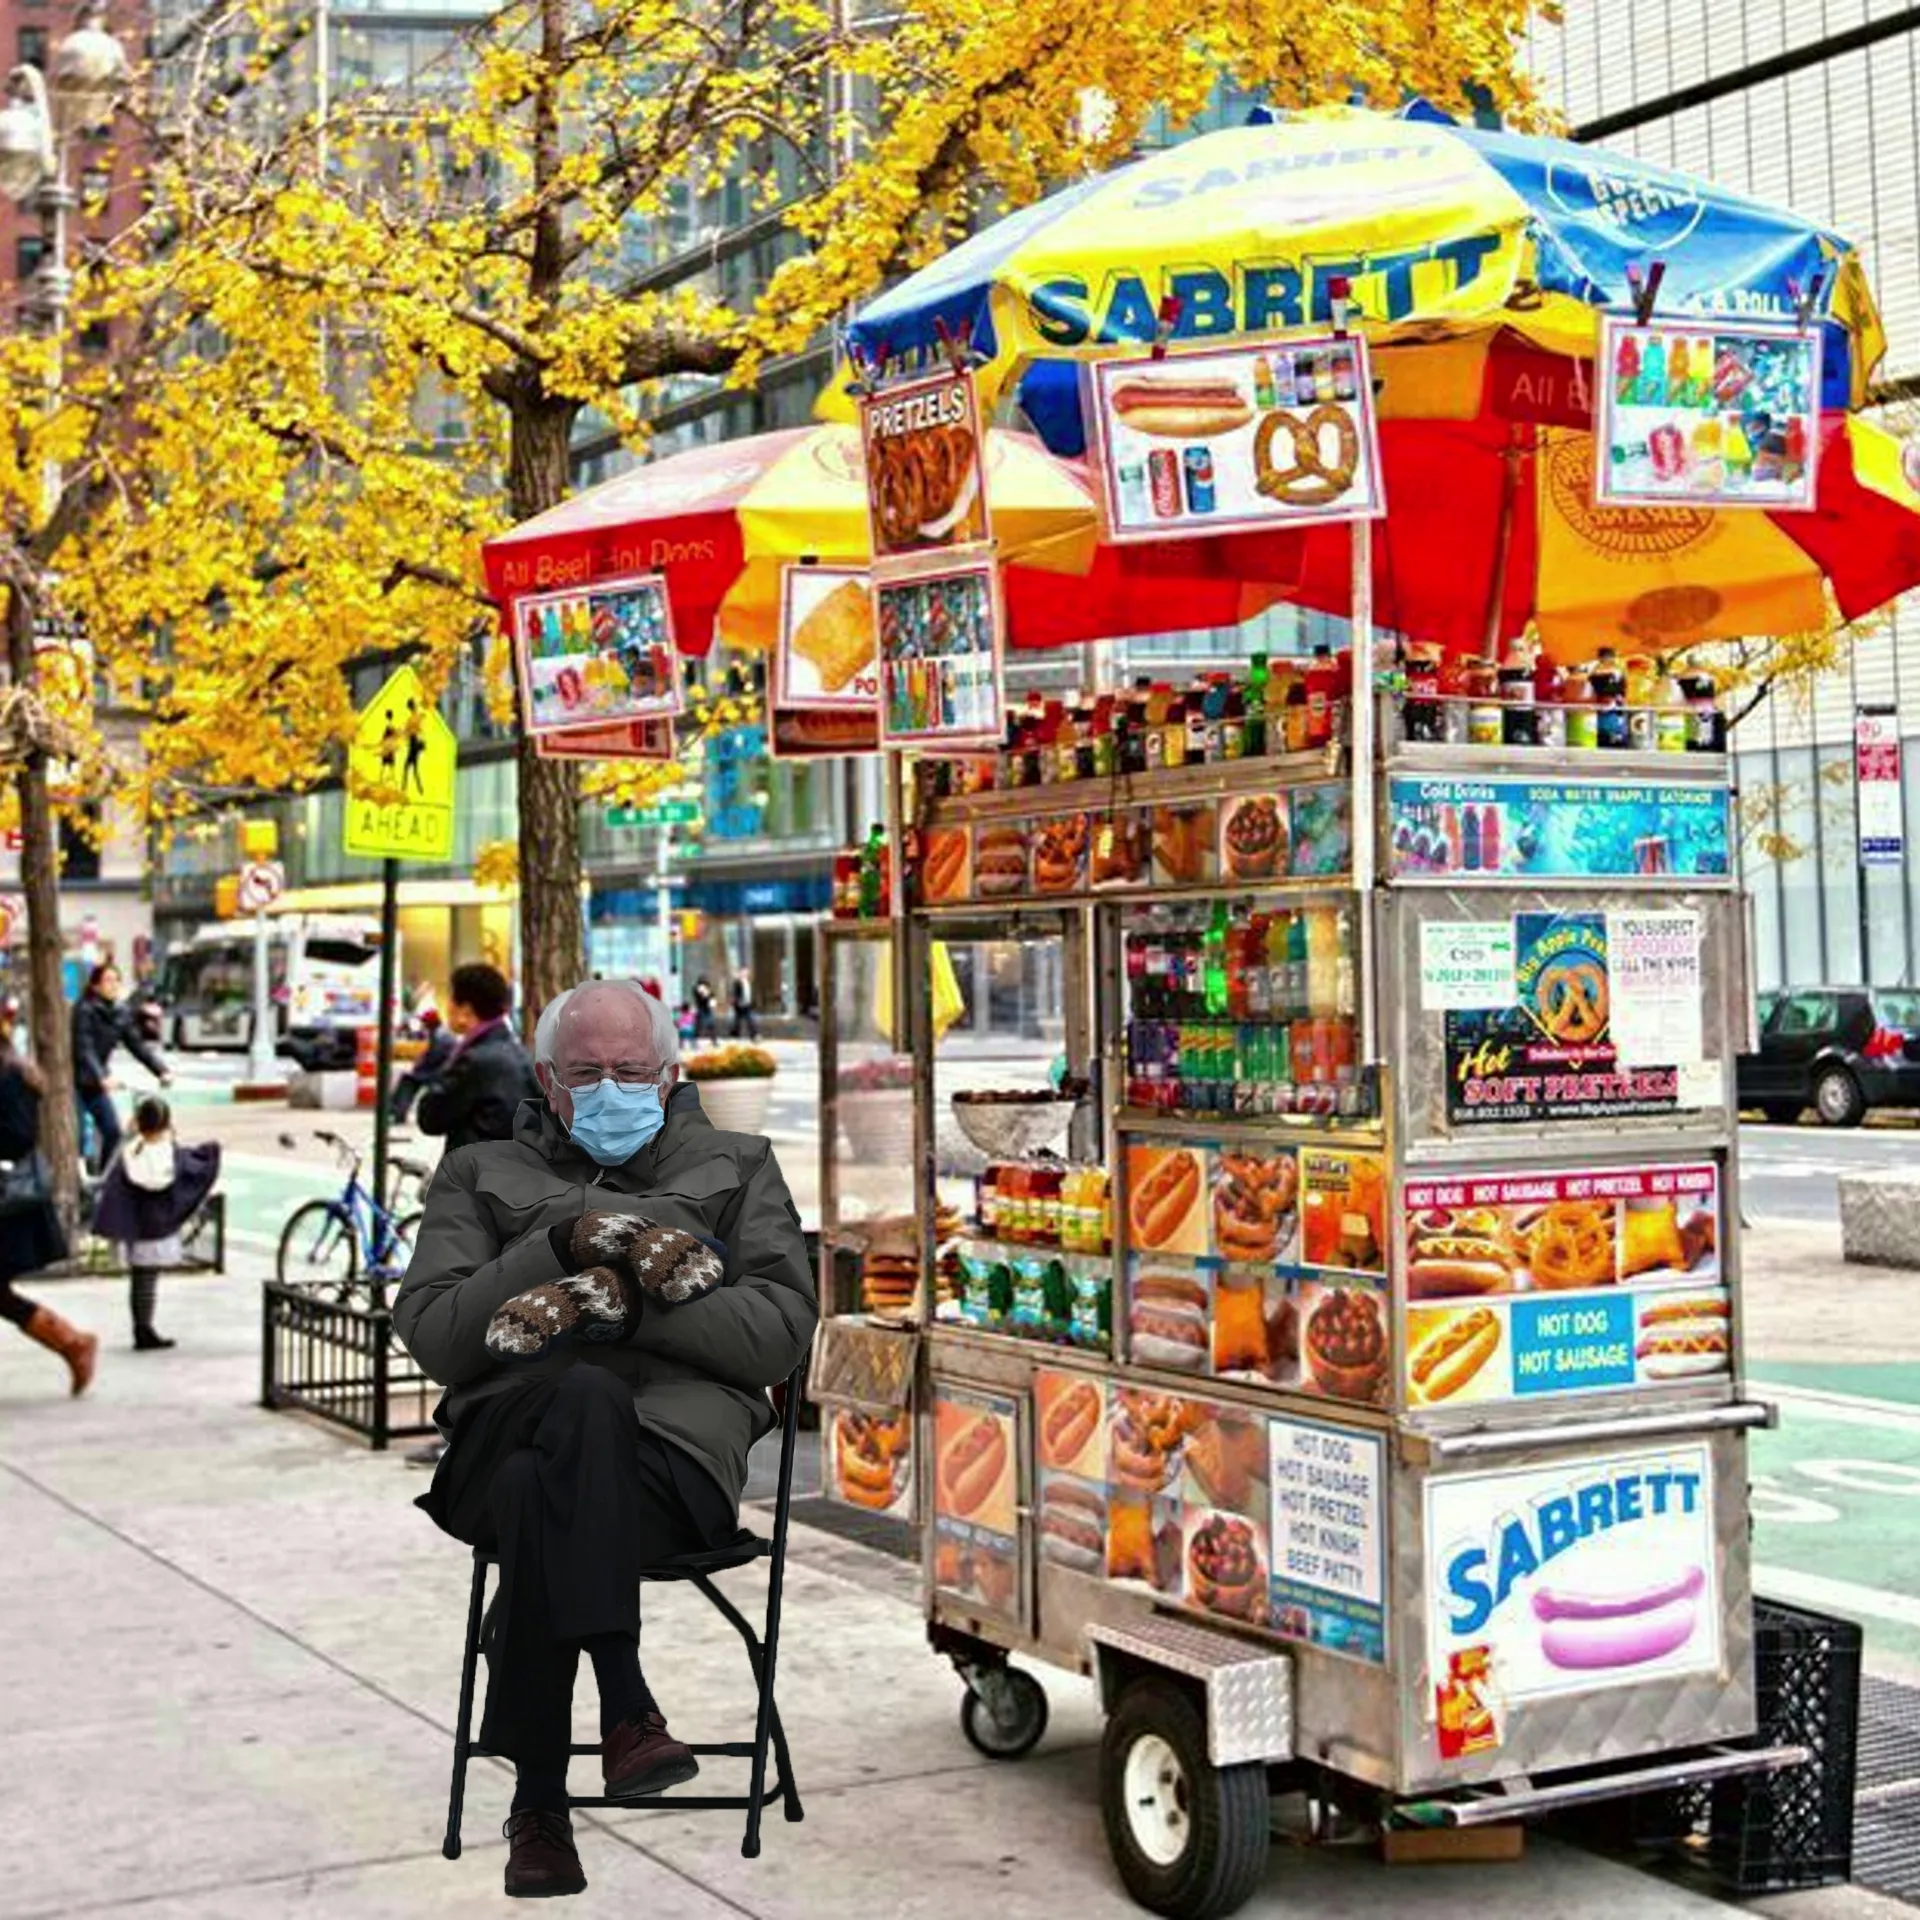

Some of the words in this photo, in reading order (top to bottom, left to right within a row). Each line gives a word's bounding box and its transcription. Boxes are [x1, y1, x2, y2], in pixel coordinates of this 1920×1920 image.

[1027, 232, 1502, 346] SABRETT
[868, 386, 966, 437] PRETZELS
[503, 560, 530, 587] All
[360, 808, 439, 845] AHEAD
[1458, 1039, 1511, 1082] Hot
[1463, 1077, 1542, 1106] SOFT
[1408, 1187, 1434, 1207] HOT
[1436, 1186, 1465, 1205] DOG
[1473, 1183, 1499, 1203] HOT
[1501, 1180, 1558, 1201] SAUSAGE
[1566, 1177, 1592, 1198] HOT
[1651, 1172, 1675, 1192] HOT
[1537, 1311, 1571, 1338] HOT
[1574, 1308, 1609, 1336] DOG
[1518, 1348, 1552, 1375] HOT
[1555, 1342, 1629, 1372] SAUSAGE
[1293, 1431, 1319, 1458] HOT
[1321, 1437, 1353, 1464] DOG
[1277, 1457, 1304, 1483] HOT
[1307, 1463, 1370, 1499] SAUSAGE
[1281, 1489, 1307, 1517] HOT
[1310, 1493, 1368, 1529] PRETZEL
[1288, 1520, 1316, 1547] HOT
[1286, 1548, 1319, 1576] BEEF
[1324, 1557, 1363, 1590] PATTY
[1447, 1473, 1700, 1636] SABRETT
